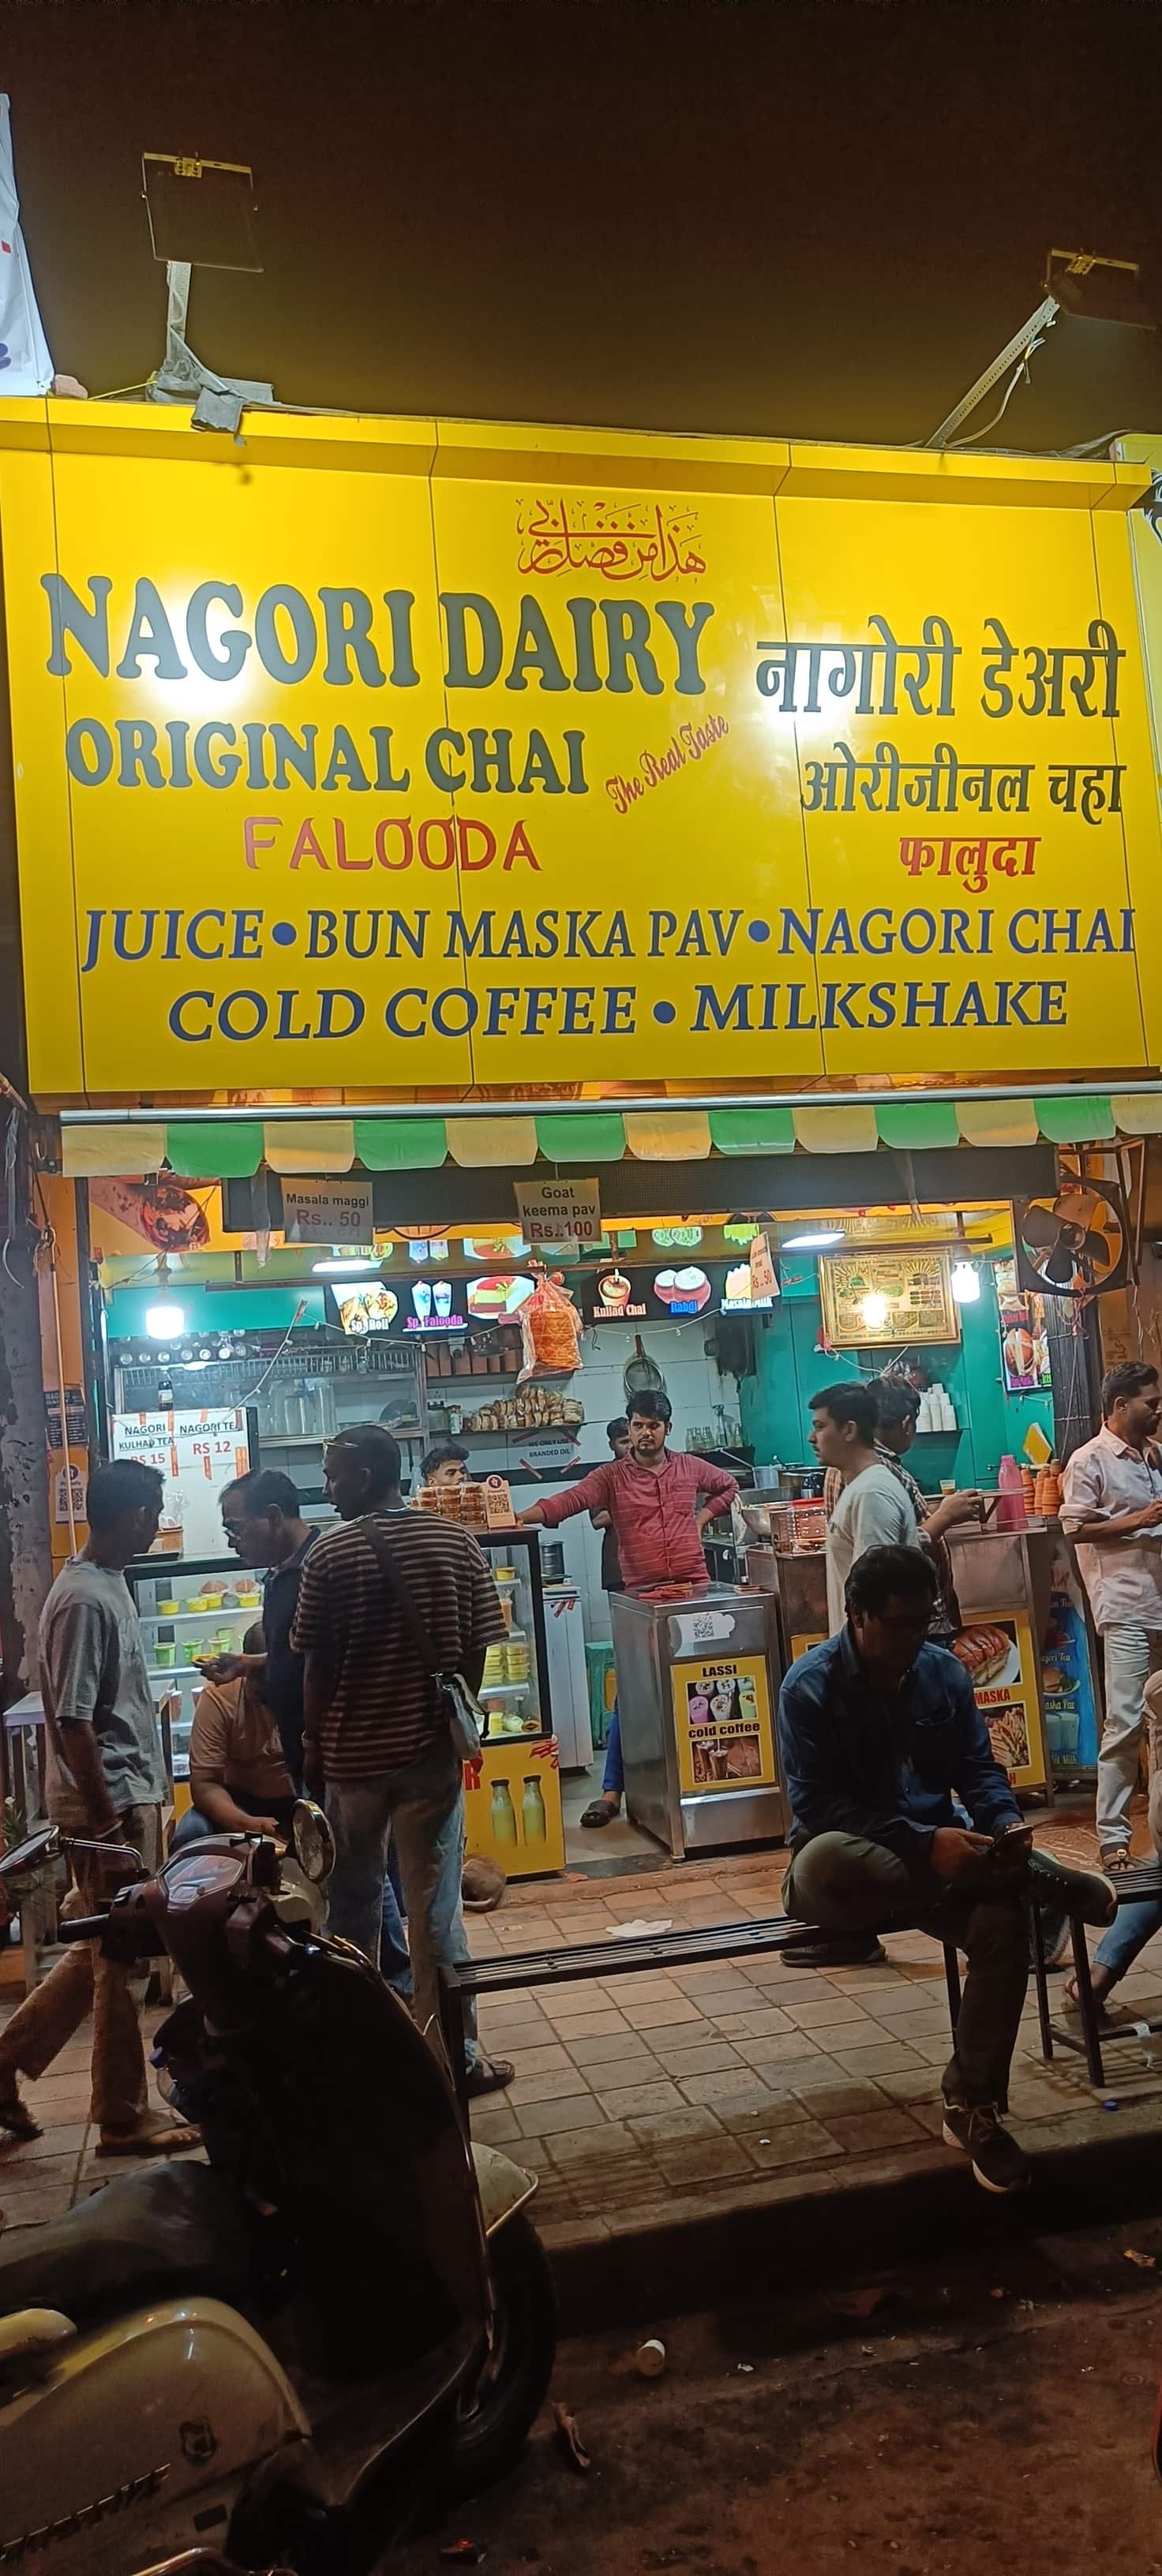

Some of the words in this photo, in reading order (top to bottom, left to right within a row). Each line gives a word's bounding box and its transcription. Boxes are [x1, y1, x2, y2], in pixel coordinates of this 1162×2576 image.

[40, 574, 421, 687] NAGORI
[439, 592, 715, 695] DAIRY
[755, 614, 961, 717] नागोरी
[980, 618, 1126, 718] डेअरी
[66, 717, 410, 791] ORIGINAL
[425, 728, 590, 795] CHAI
[605, 774, 645, 814] The
[639, 736, 686, 788] Real
[679, 713, 729, 760] Taste
[800, 741, 1035, 814] ओरीजीनल
[1048, 765, 1126, 826] चहा
[243, 816, 543, 872] FALOODA
[899, 837, 1042, 893] फालुदा
[81, 909, 264, 972] JUICE
[305, 910, 430, 959] BUN
[443, 910, 632, 959] MASKA
[648, 909, 744, 957] PAV
[778, 907, 994, 955] NAGORI
[1008, 908, 1137, 953] CHAI
[168, 987, 365, 1043] COLD
[384, 987, 636, 1040] COFFEE
[689, 980, 1068, 1032] MILKSHAKE
[286, 1193, 329, 1206] Masala
[332, 1194, 369, 1208] maggi
[541, 1186, 575, 1199] Goat
[339, 1211, 361, 1227] 50
[522, 1204, 568, 1217] keema
[572, 1205, 596, 1220] pav
[626, 1302, 647, 1316] Chai
[424, 1313, 464, 1327] Falooda
[125, 1423, 166, 1436] NAGORI
[179, 1421, 219, 1435] NAGORI
[119, 1438, 155, 1450] KULHAD
[157, 1436, 174, 1446] TEA
[193, 1442, 210, 1455] RS
[215, 1440, 231, 1454] 12
[151, 1453, 165, 1465] 15
[529, 1449, 559, 1458] BRANDED
[702, 1664, 737, 1677] LASSI
[975, 1688, 1011, 1705] MASKA
[688, 1725, 717, 1738] cold
[720, 1722, 760, 1735] coffee
